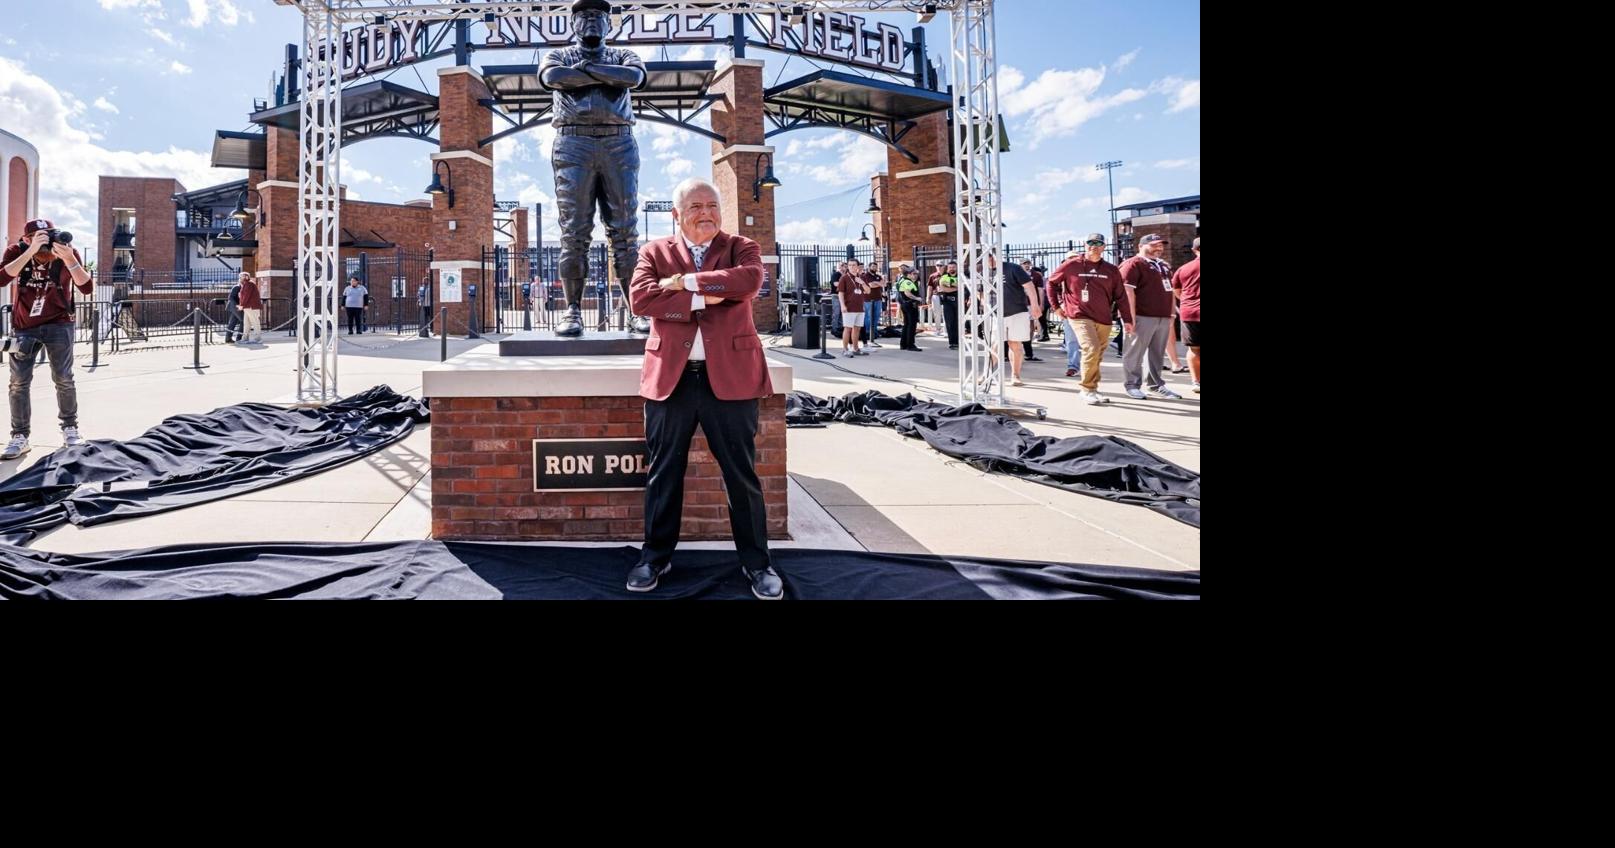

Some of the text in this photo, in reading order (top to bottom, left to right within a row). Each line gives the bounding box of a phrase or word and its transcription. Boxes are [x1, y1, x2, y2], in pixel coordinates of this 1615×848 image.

[486, 8, 715, 47] NOLE
[769, 8, 906, 73] FIELD
[545, 454, 649, 475] RON POL
